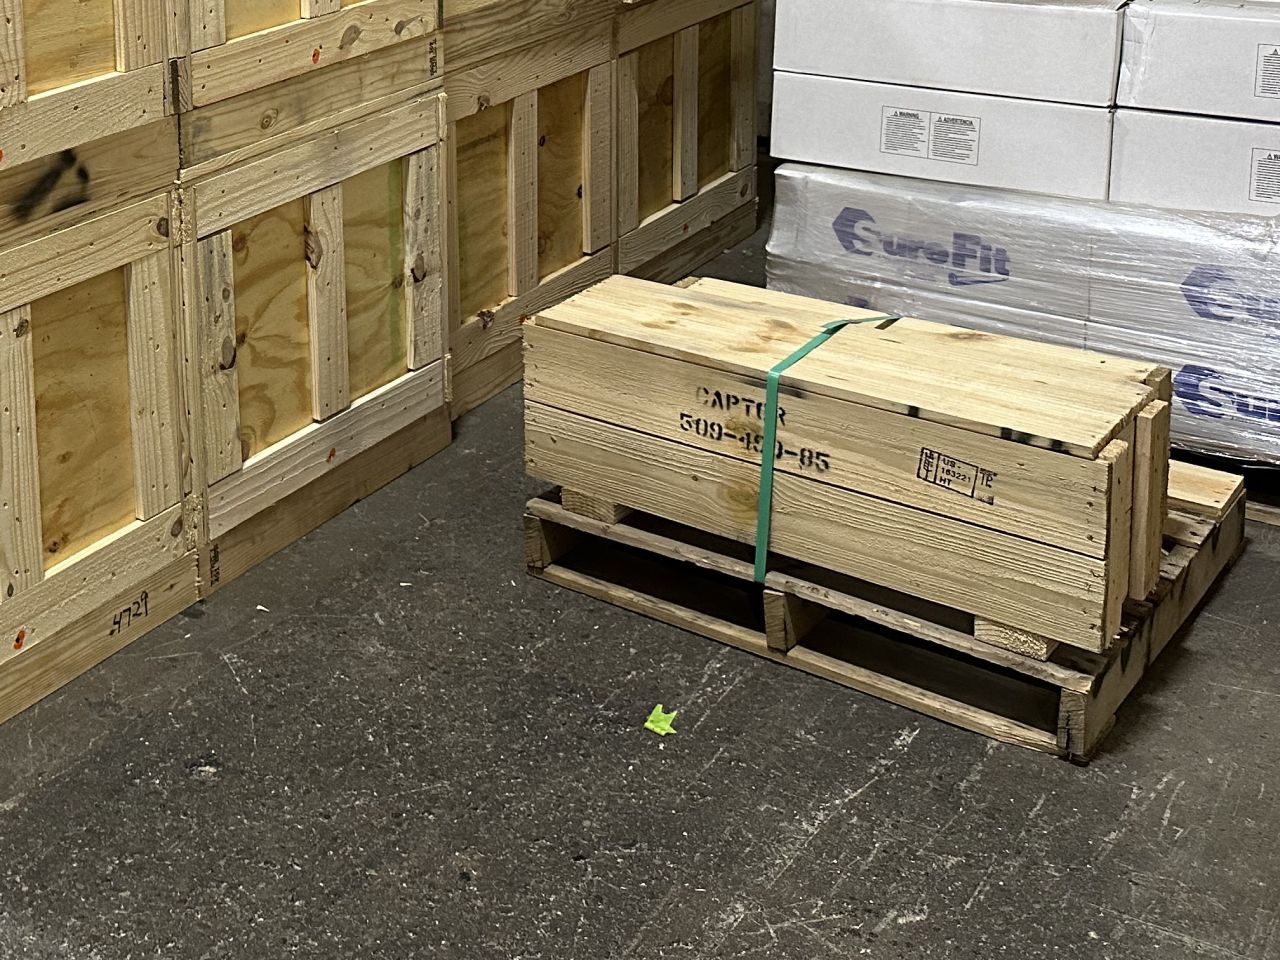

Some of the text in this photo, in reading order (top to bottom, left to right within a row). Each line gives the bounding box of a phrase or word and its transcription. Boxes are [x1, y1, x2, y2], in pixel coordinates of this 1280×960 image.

[899, 111, 920, 120] WARNING
[939, 476, 953, 487] HT
[941, 467, 972, 483] 163221
[112, 590, 149, 634] 4729
